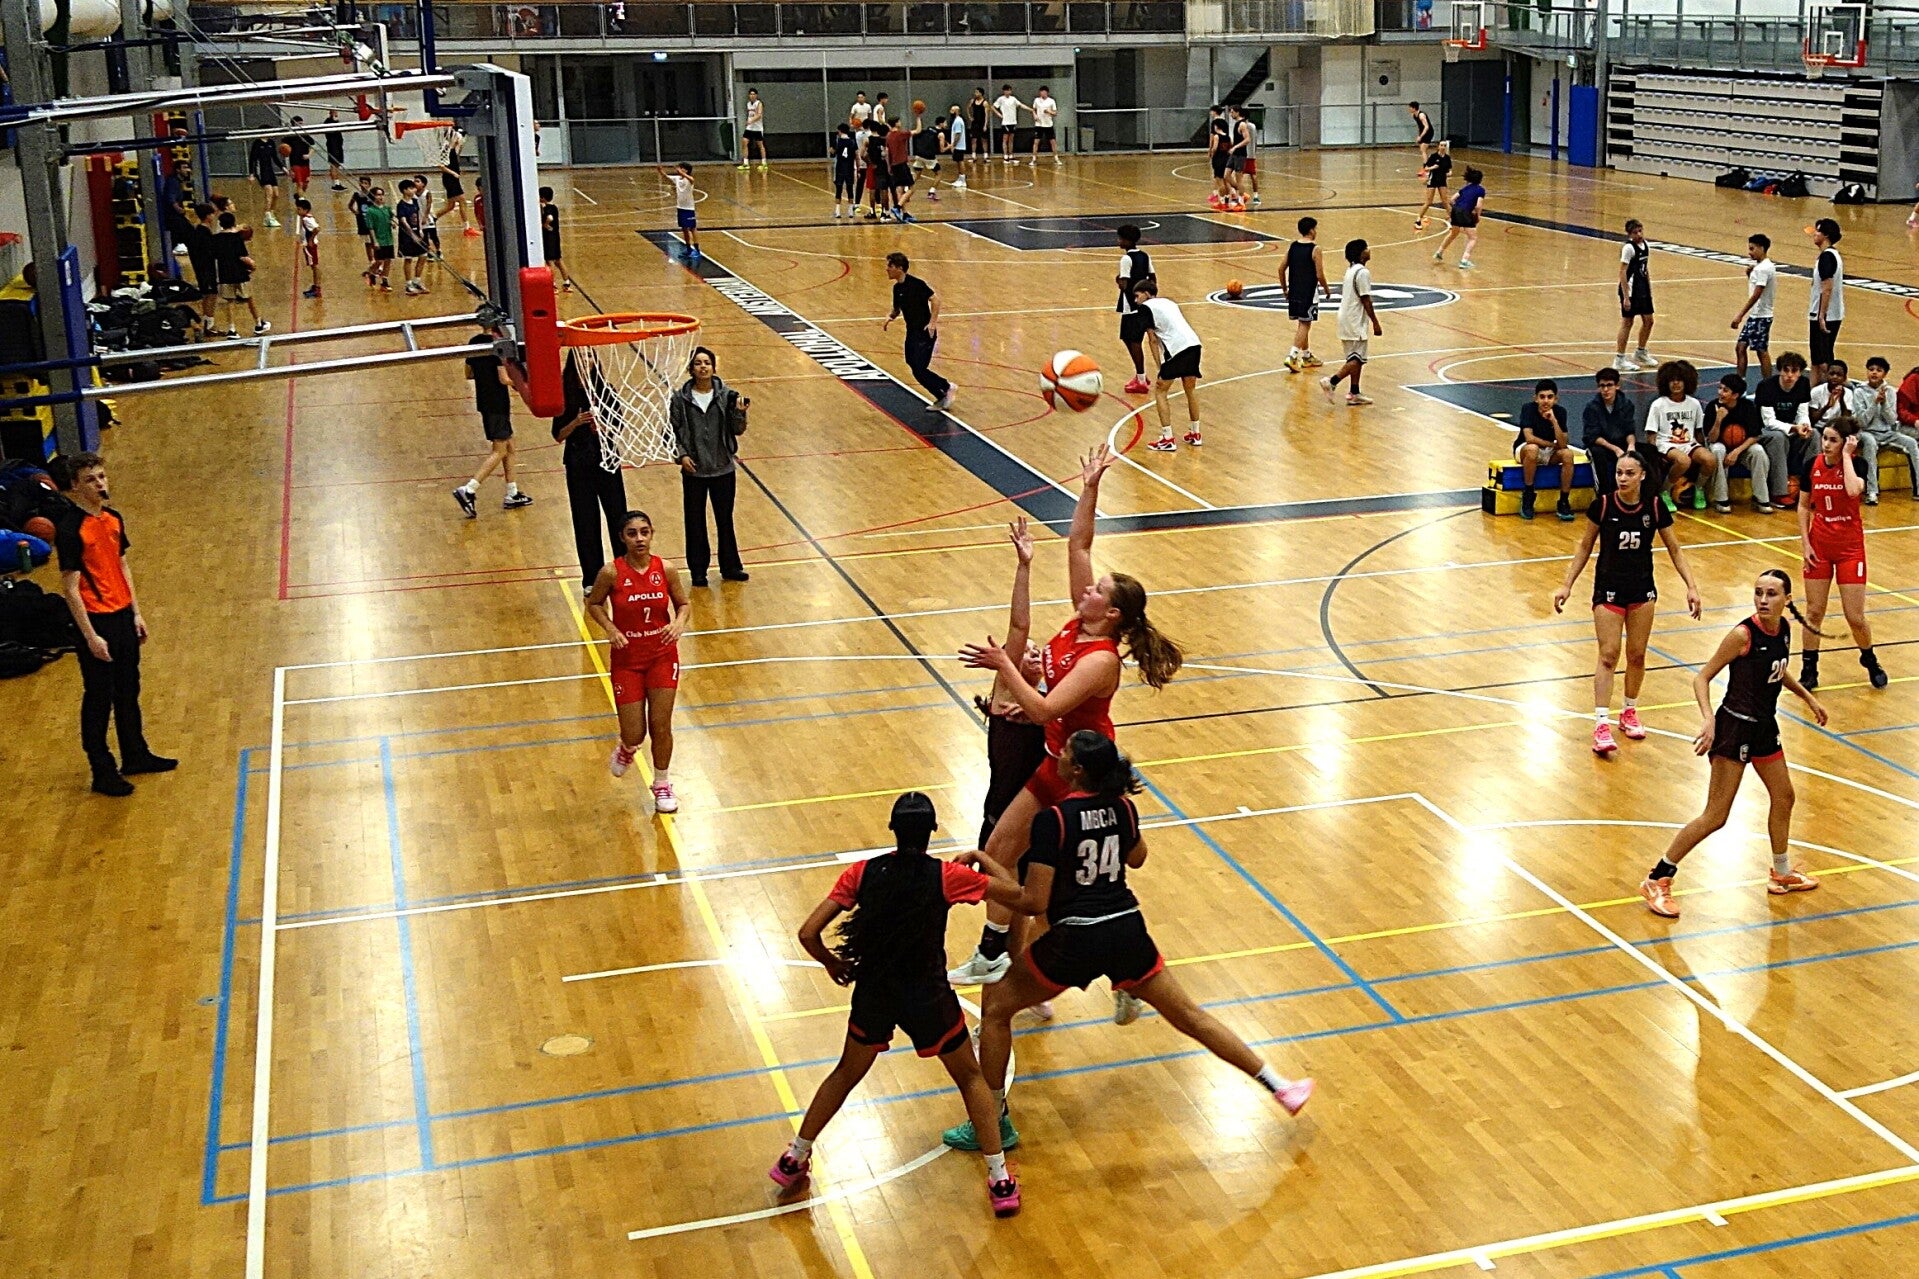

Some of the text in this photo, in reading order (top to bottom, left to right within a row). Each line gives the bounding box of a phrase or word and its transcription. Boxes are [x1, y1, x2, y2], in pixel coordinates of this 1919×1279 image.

[842, 147, 848, 158] 4
[703, 277, 890, 380] APOLLOHAL AMSTERDAM
[1619, 531, 1641, 550] 25
[628, 592, 664, 602] APOLLO
[644, 607, 651, 623] 2
[626, 630, 643, 638] Club
[672, 662, 679, 681] 2
[1075, 834, 1121, 886] 34
